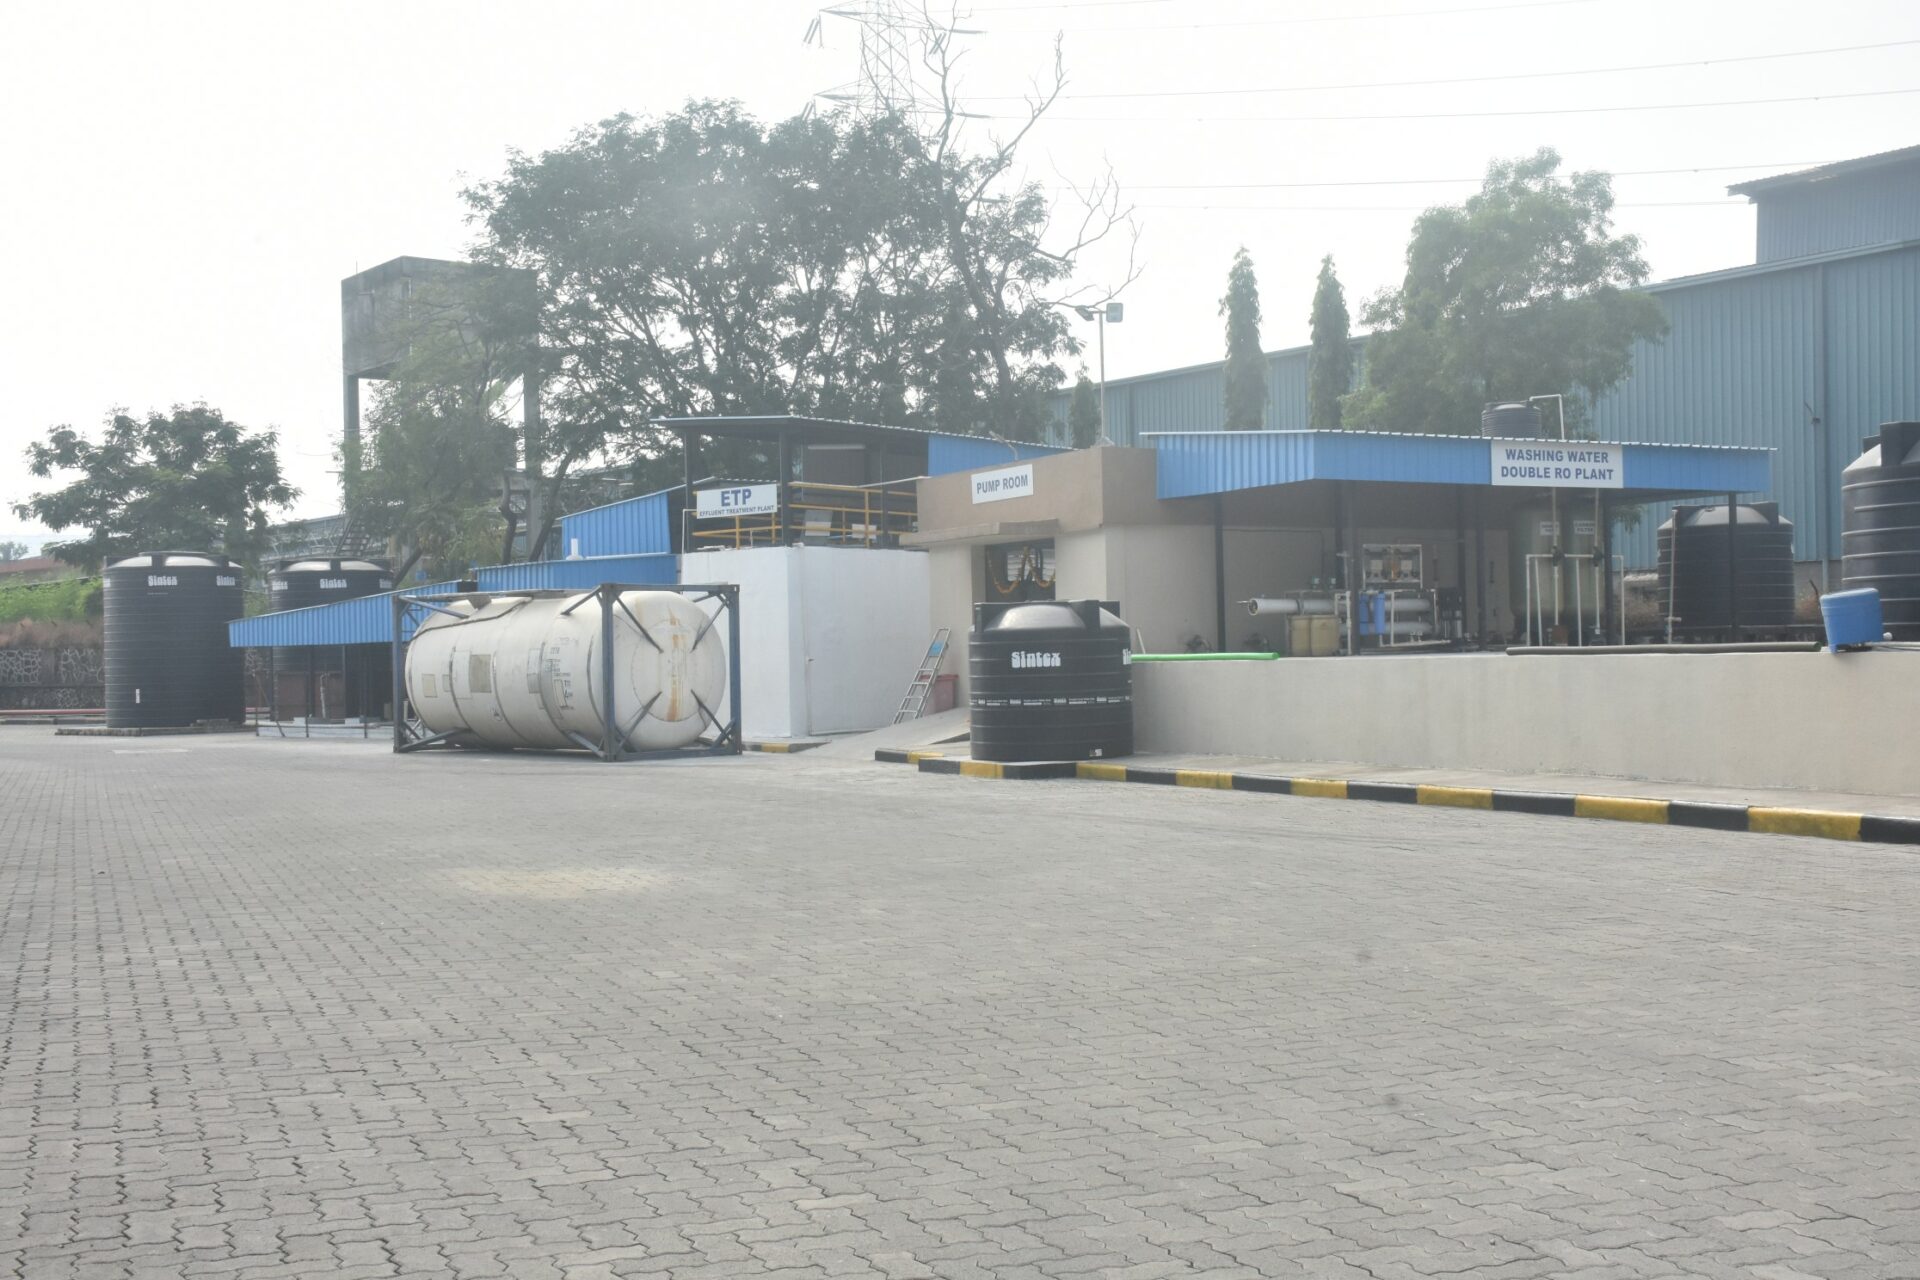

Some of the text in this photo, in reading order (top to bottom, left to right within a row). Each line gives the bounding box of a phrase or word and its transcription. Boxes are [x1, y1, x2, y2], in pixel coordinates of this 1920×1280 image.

[1505, 448, 1609, 464] WASHING WATER
[1501, 466, 1614, 480] DOUBLE RO PLANT
[976, 474, 1028, 495] PUMP ROOM
[721, 488, 752, 507] ETP
[699, 509, 725, 517] EFFLUENT
[726, 506, 756, 515] TREATMENT
[1011, 651, 1061, 669] Sintex
